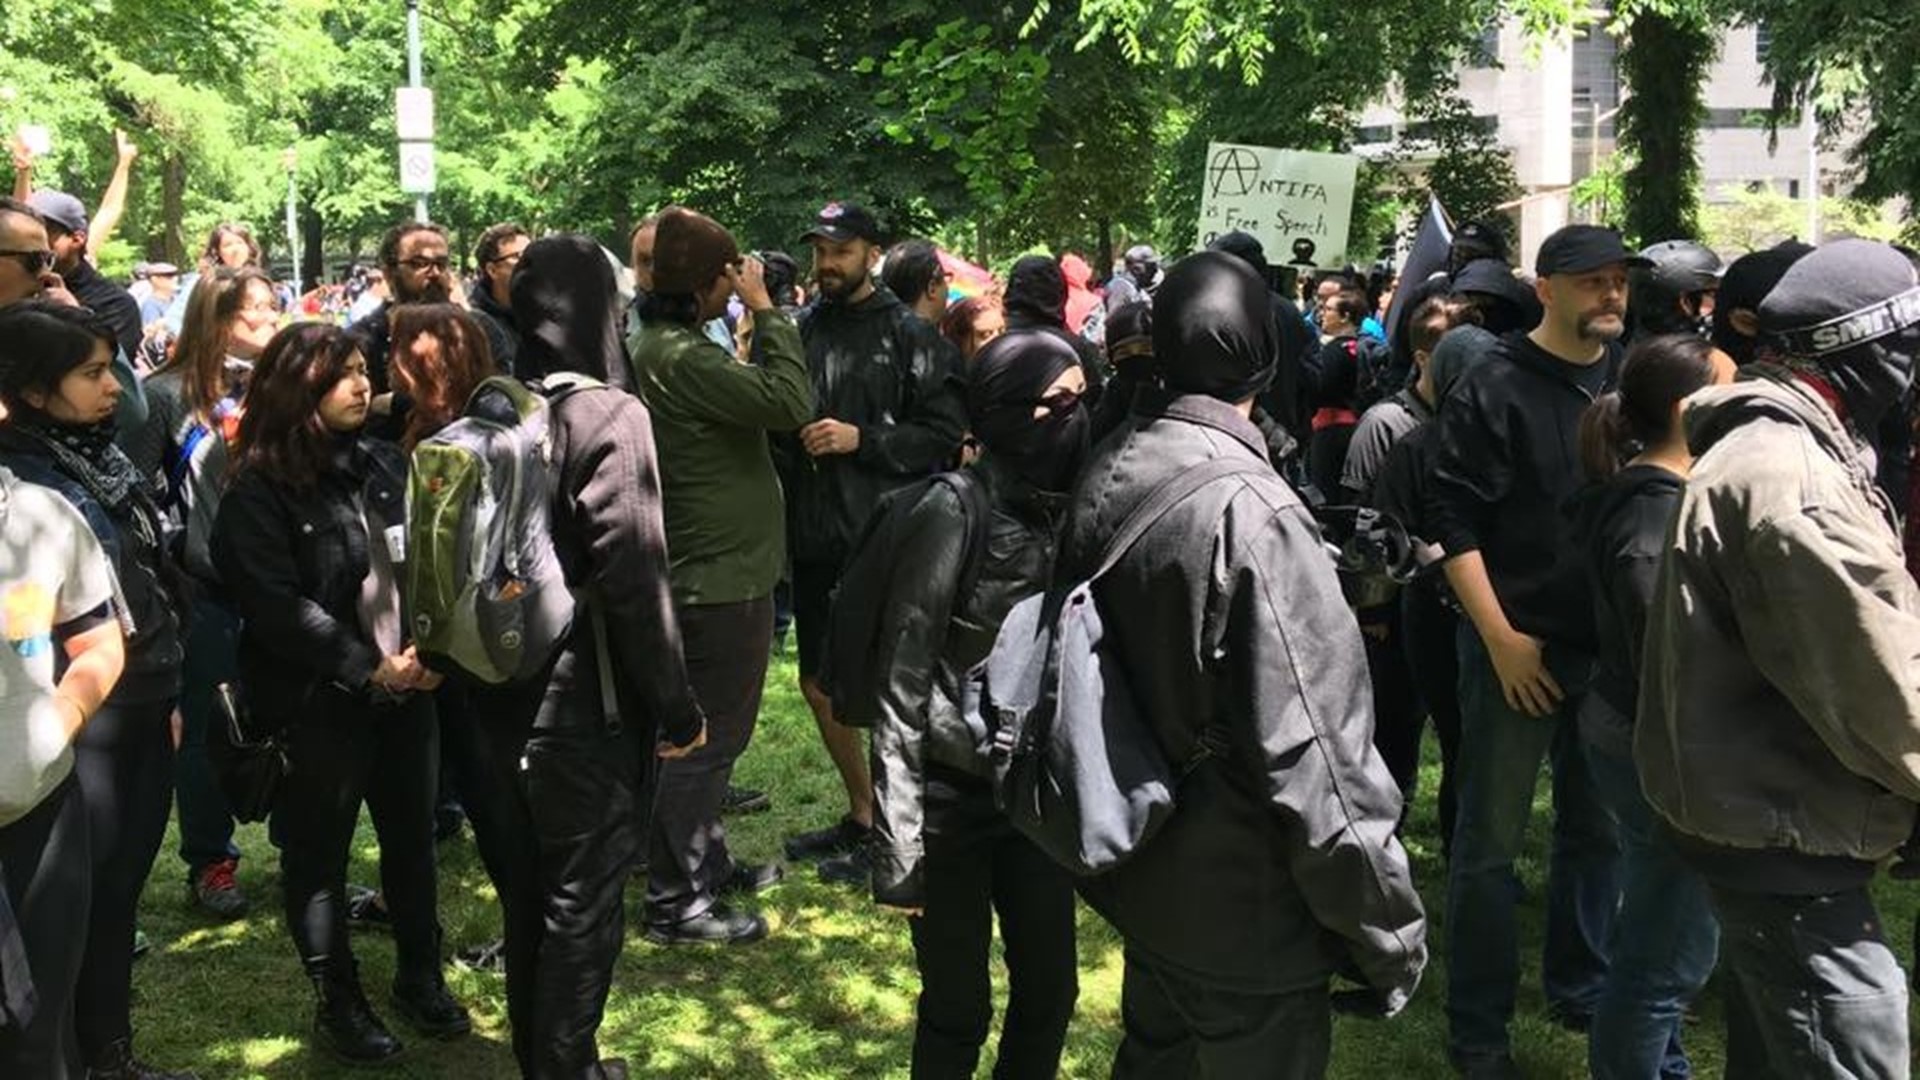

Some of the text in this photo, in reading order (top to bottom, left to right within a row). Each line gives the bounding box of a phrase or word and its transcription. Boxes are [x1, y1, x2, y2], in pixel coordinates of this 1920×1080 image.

[1209, 148, 1328, 204] ANTIFA
[1225, 207, 1259, 230] Free
[1274, 209, 1328, 236] Speech
